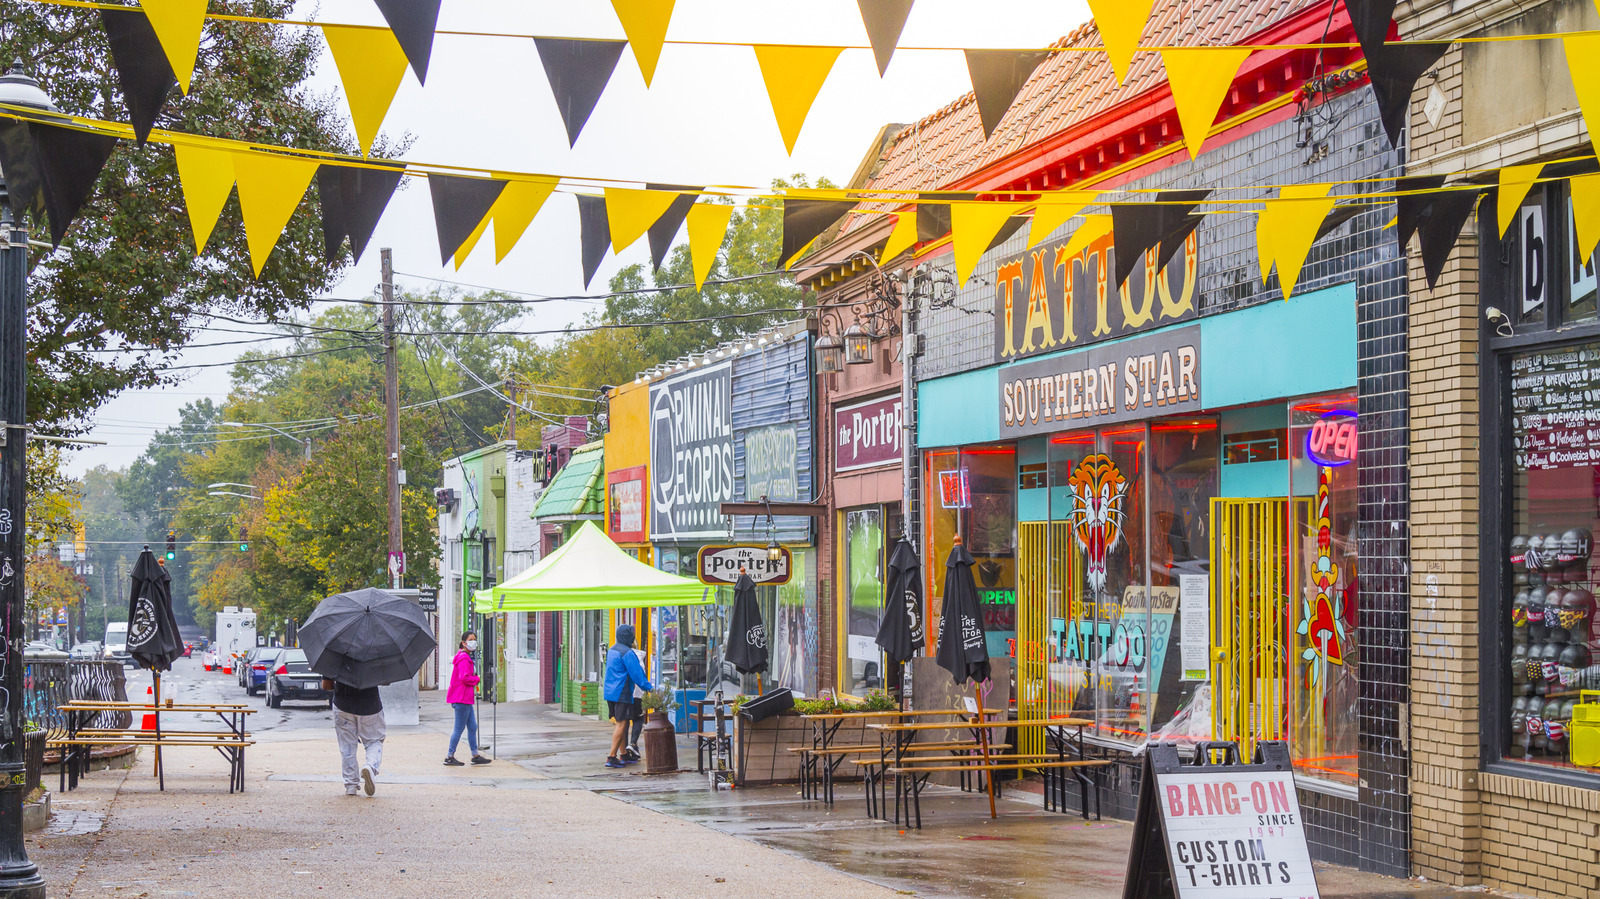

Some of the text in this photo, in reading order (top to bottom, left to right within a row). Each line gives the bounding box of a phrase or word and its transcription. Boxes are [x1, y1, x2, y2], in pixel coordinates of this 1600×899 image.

[1003, 345, 1199, 428] SOUTHERN STAR
[1553, 410, 1585, 424] DEMODE
[839, 424, 852, 447] the
[1310, 419, 1358, 460] OPEN
[1555, 450, 1589, 463] Coolvetica
[738, 549, 752, 557] the
[977, 590, 1016, 605] OPEN
[1071, 601, 1125, 619] SOUTHERN
[1052, 617, 1146, 671] TATTOO
[1081, 671, 1113, 692] STAR
[1166, 781, 1291, 817] BANG-ON
[1258, 814, 1295, 826] SINCE
[1176, 839, 1266, 864] CUSTOM
